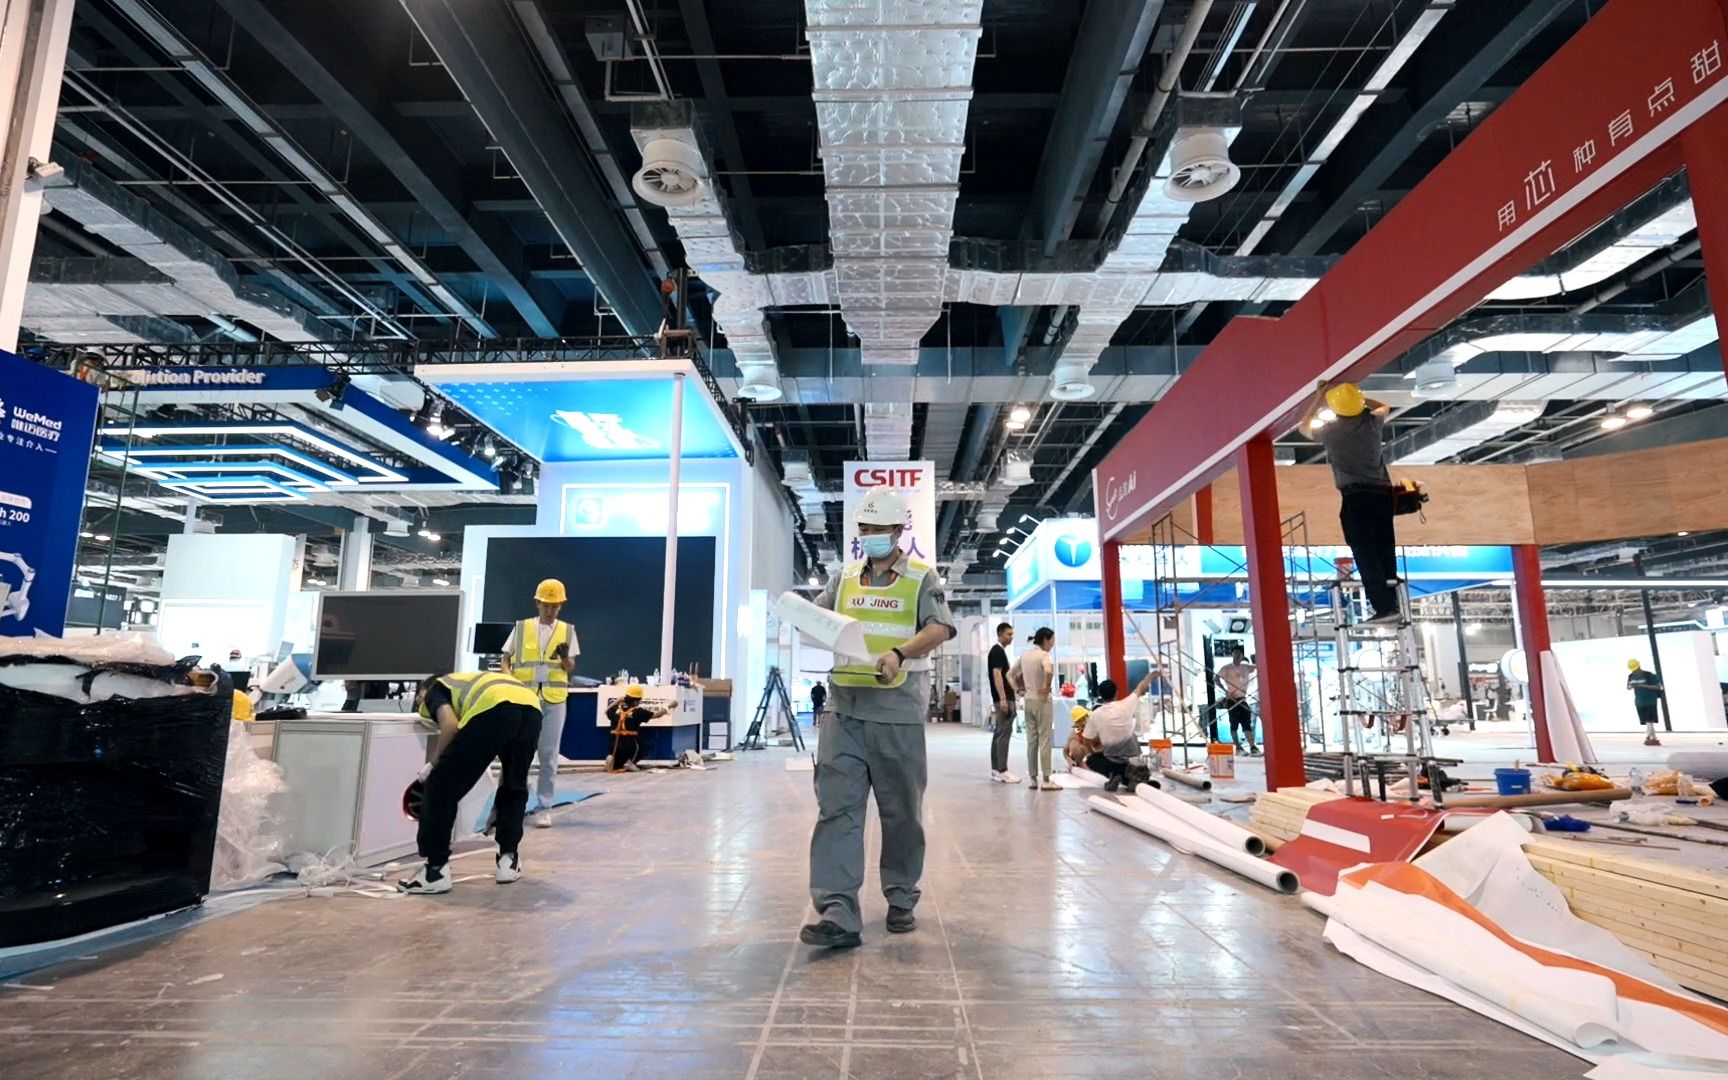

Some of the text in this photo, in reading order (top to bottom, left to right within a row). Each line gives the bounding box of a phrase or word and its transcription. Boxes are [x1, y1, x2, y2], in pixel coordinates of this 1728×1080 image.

[1496, 39, 1722, 233] 用芯种有点甜
[192, 368, 266, 385] Provider
[13, 406, 62, 431] WeMed
[854, 468, 924, 488] CSITF
[9, 509, 30, 523] 200
[870, 598, 899, 609] JING
